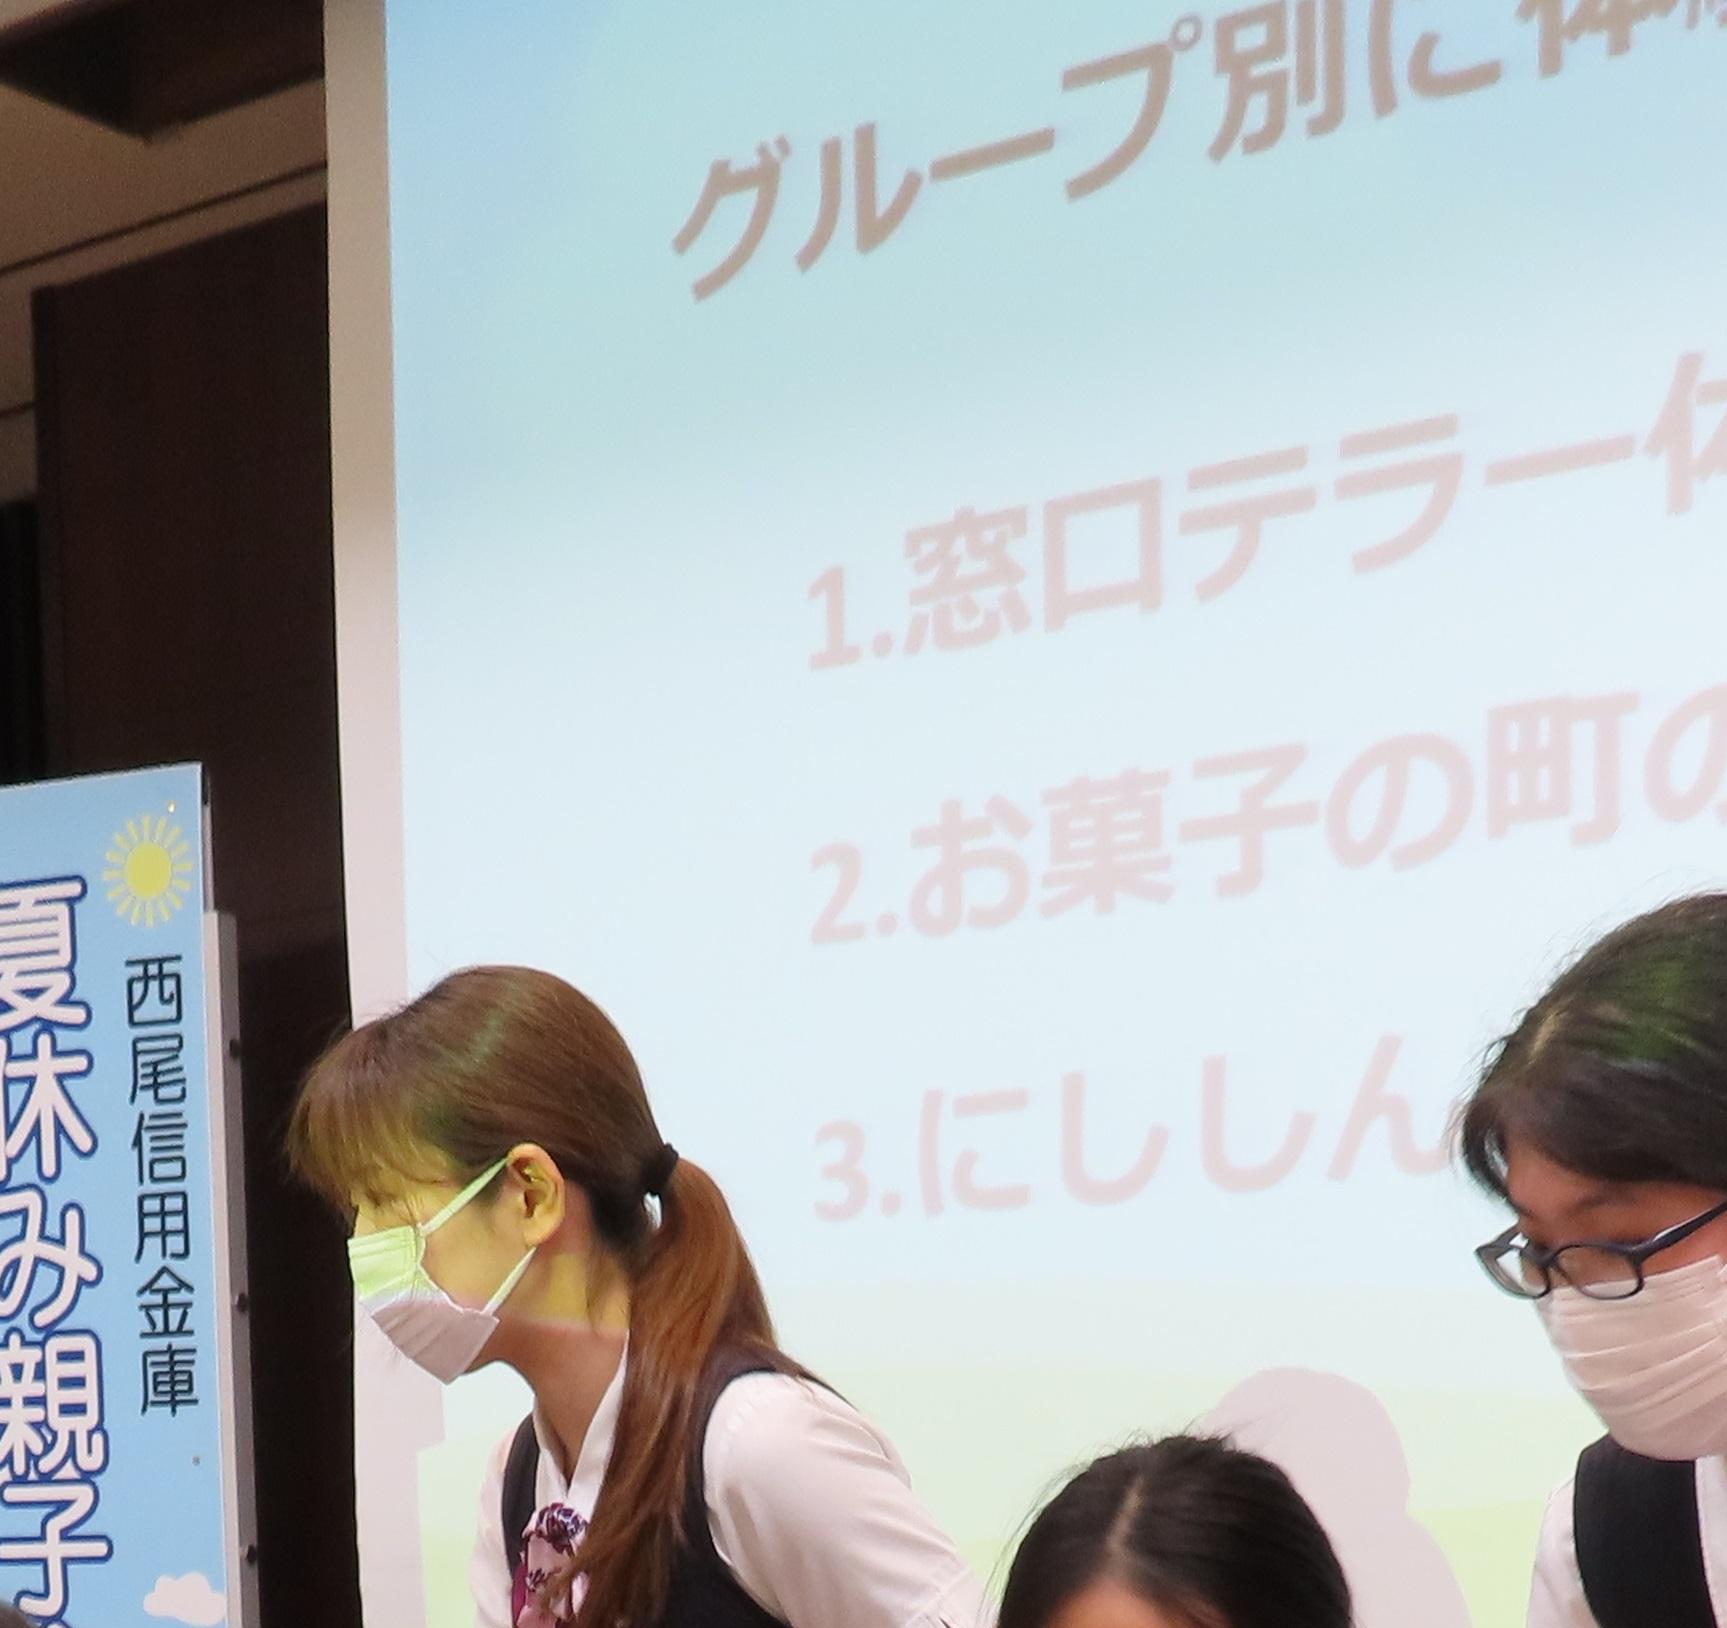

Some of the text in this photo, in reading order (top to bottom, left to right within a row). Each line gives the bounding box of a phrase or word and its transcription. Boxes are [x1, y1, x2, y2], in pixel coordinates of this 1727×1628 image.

[124, 954, 200, 1416] 西尾信用金庫
